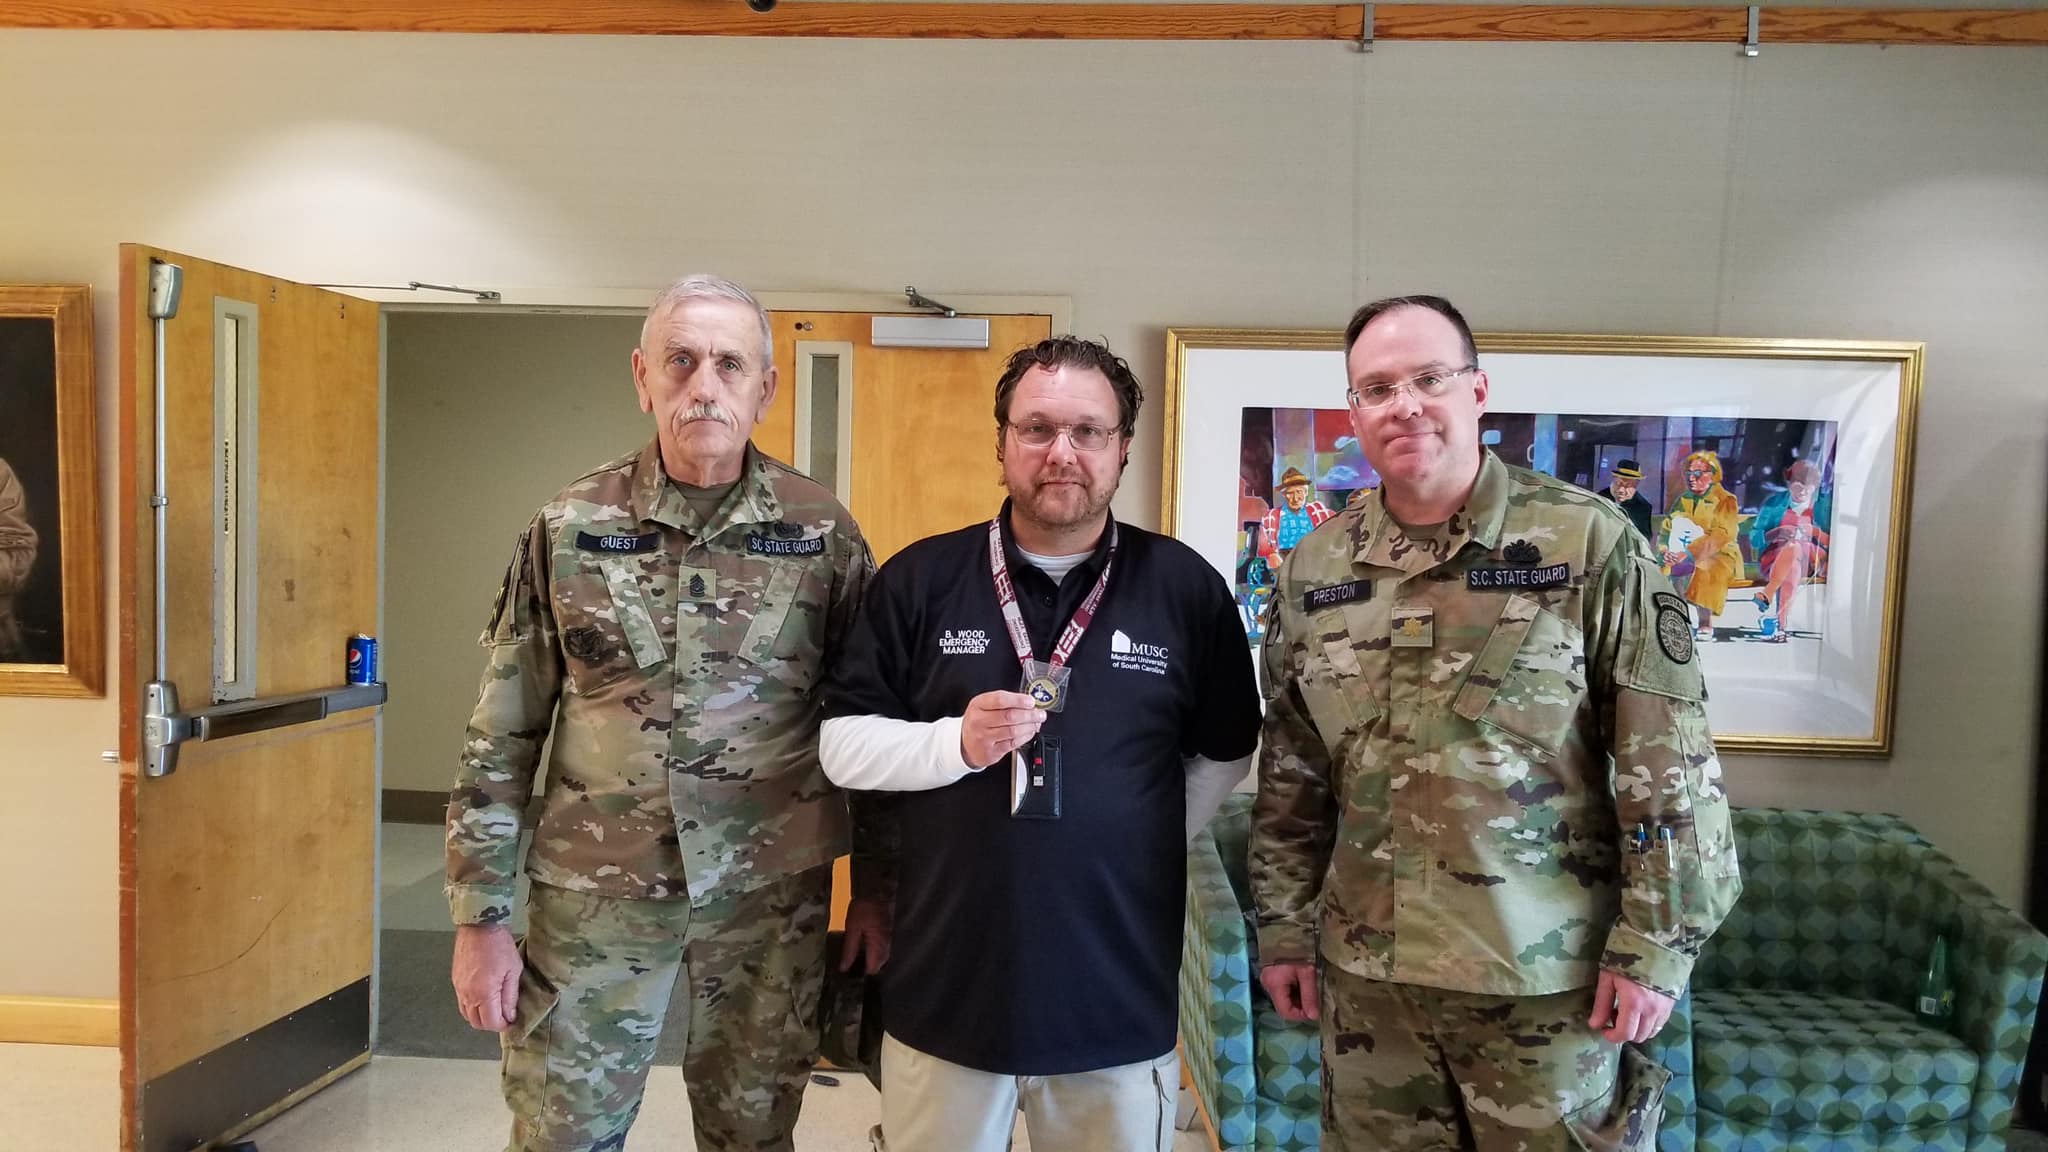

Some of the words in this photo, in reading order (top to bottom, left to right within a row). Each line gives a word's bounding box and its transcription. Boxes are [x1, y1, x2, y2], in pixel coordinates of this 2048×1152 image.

[600, 535, 639, 550] GUEST
[751, 537, 763, 551] SC
[764, 540, 791, 553] STATE
[792, 539, 822, 554] GUARD
[1470, 570, 1492, 586] S.C.
[1495, 570, 1528, 585] STATE
[1530, 566, 1566, 584] GUARD
[1313, 583, 1356, 605] PRESTON
[957, 629, 986, 639] WOOD
[939, 638, 991, 647] EMERGENCY
[942, 646, 986, 655] MANAGER
[1131, 642, 1169, 659] MUSC
[1110, 652, 1137, 662] Medical
[1137, 655, 1168, 669] University
[1112, 661, 1120, 669] of
[1120, 661, 1141, 670] South
[1141, 664, 1166, 675] Carolina
